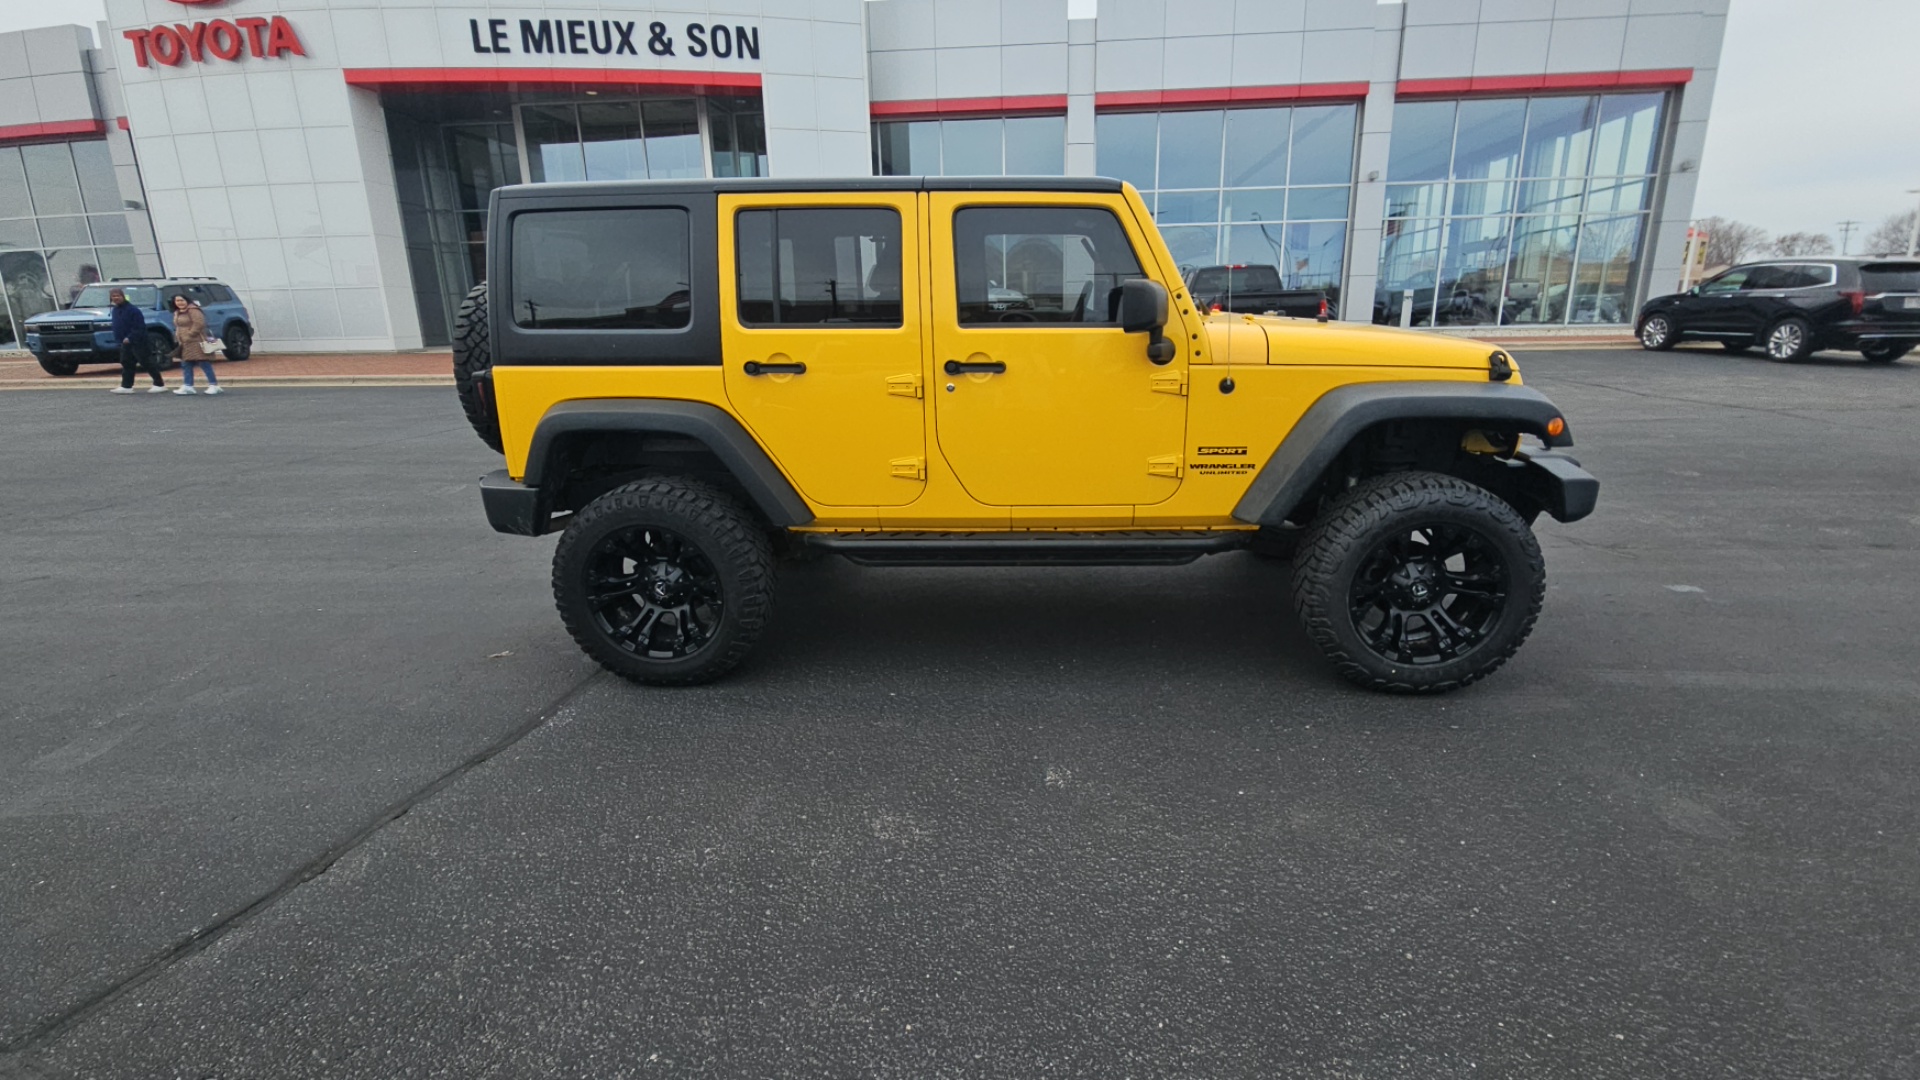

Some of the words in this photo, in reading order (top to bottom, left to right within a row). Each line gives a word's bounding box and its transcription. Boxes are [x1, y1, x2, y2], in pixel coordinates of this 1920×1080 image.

[123, 15, 306, 68] TOYOTA
[469, 19, 511, 53] LE
[519, 19, 638, 55] MIEUX
[648, 21, 676, 56] &
[686, 23, 760, 59] SON
